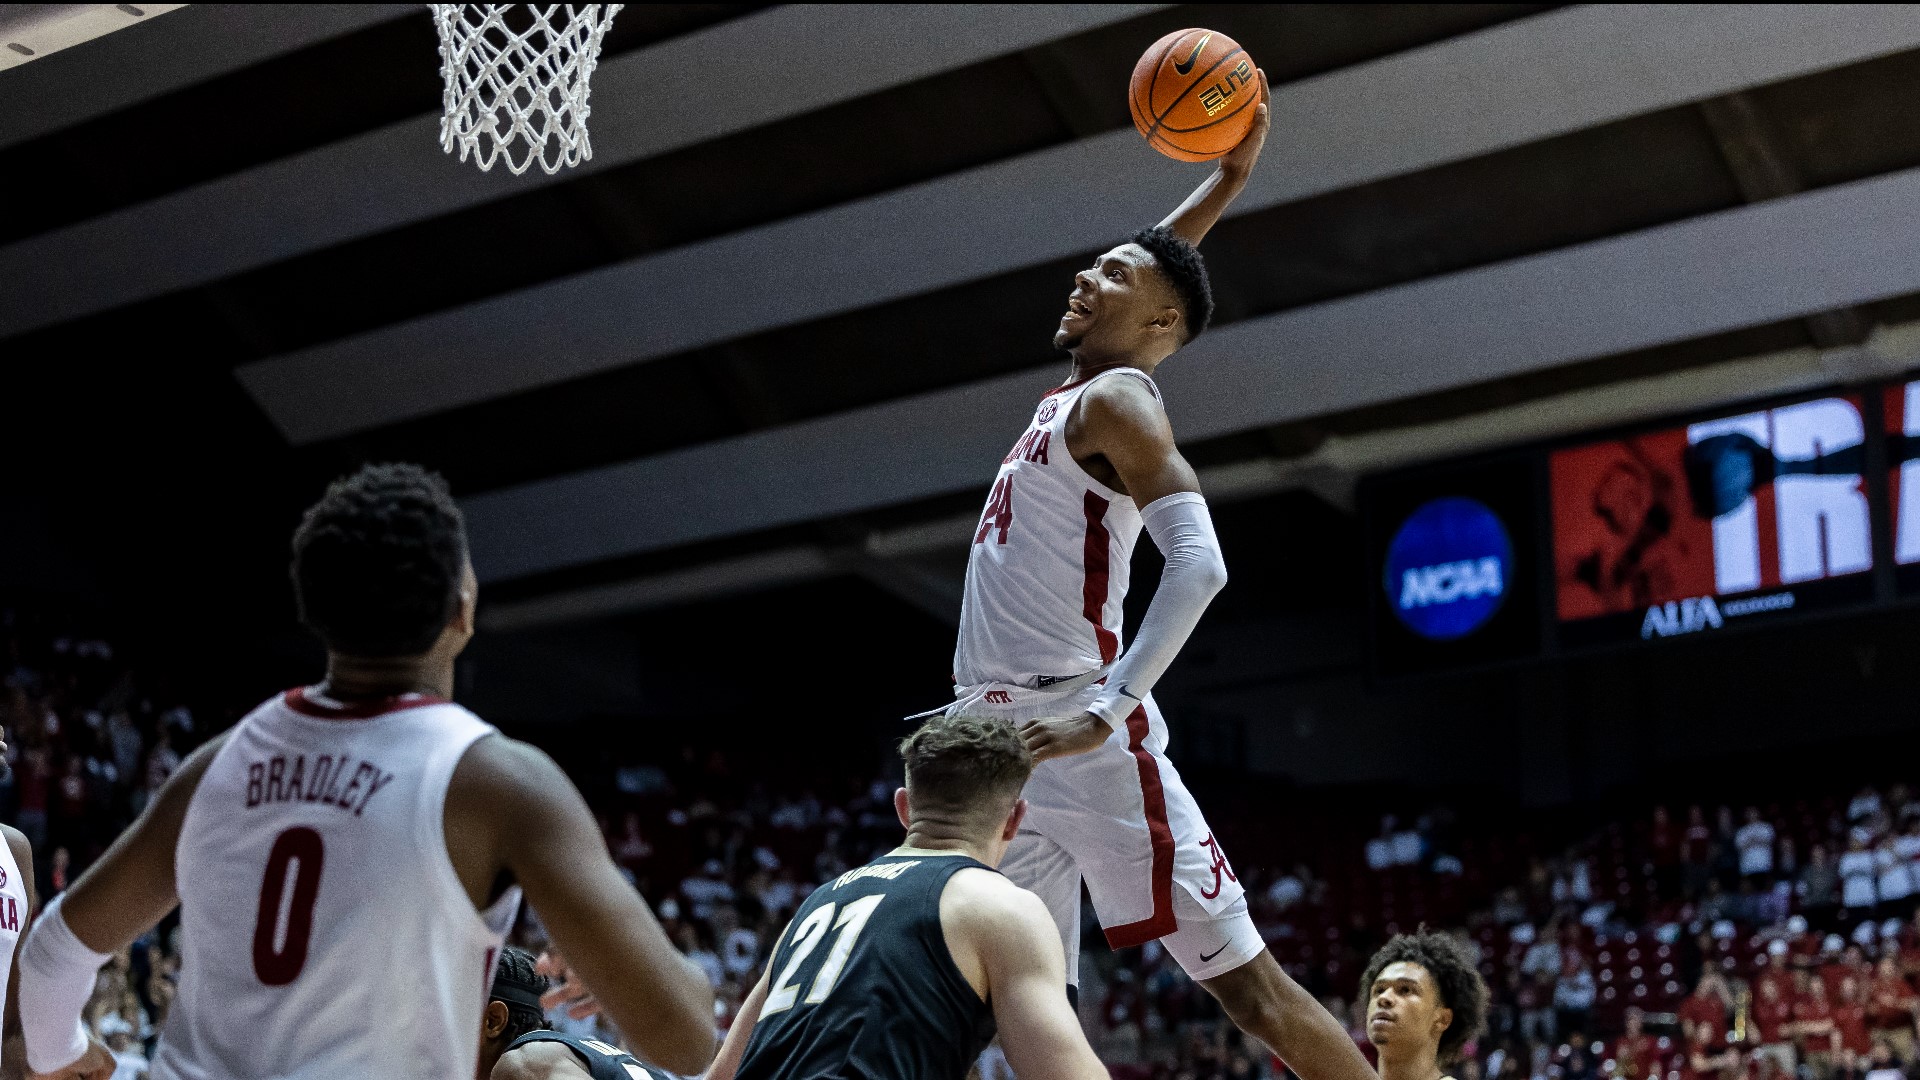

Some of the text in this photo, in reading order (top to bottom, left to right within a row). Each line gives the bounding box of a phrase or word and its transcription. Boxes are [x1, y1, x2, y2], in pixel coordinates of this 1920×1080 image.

[1198, 60, 1252, 111] ELITE
[975, 474, 1013, 544] 24
[1400, 556, 1503, 609] NCAA
[246, 754, 394, 817] BRADLEY
[253, 825, 324, 987] 0
[757, 893, 887, 1022] 21
